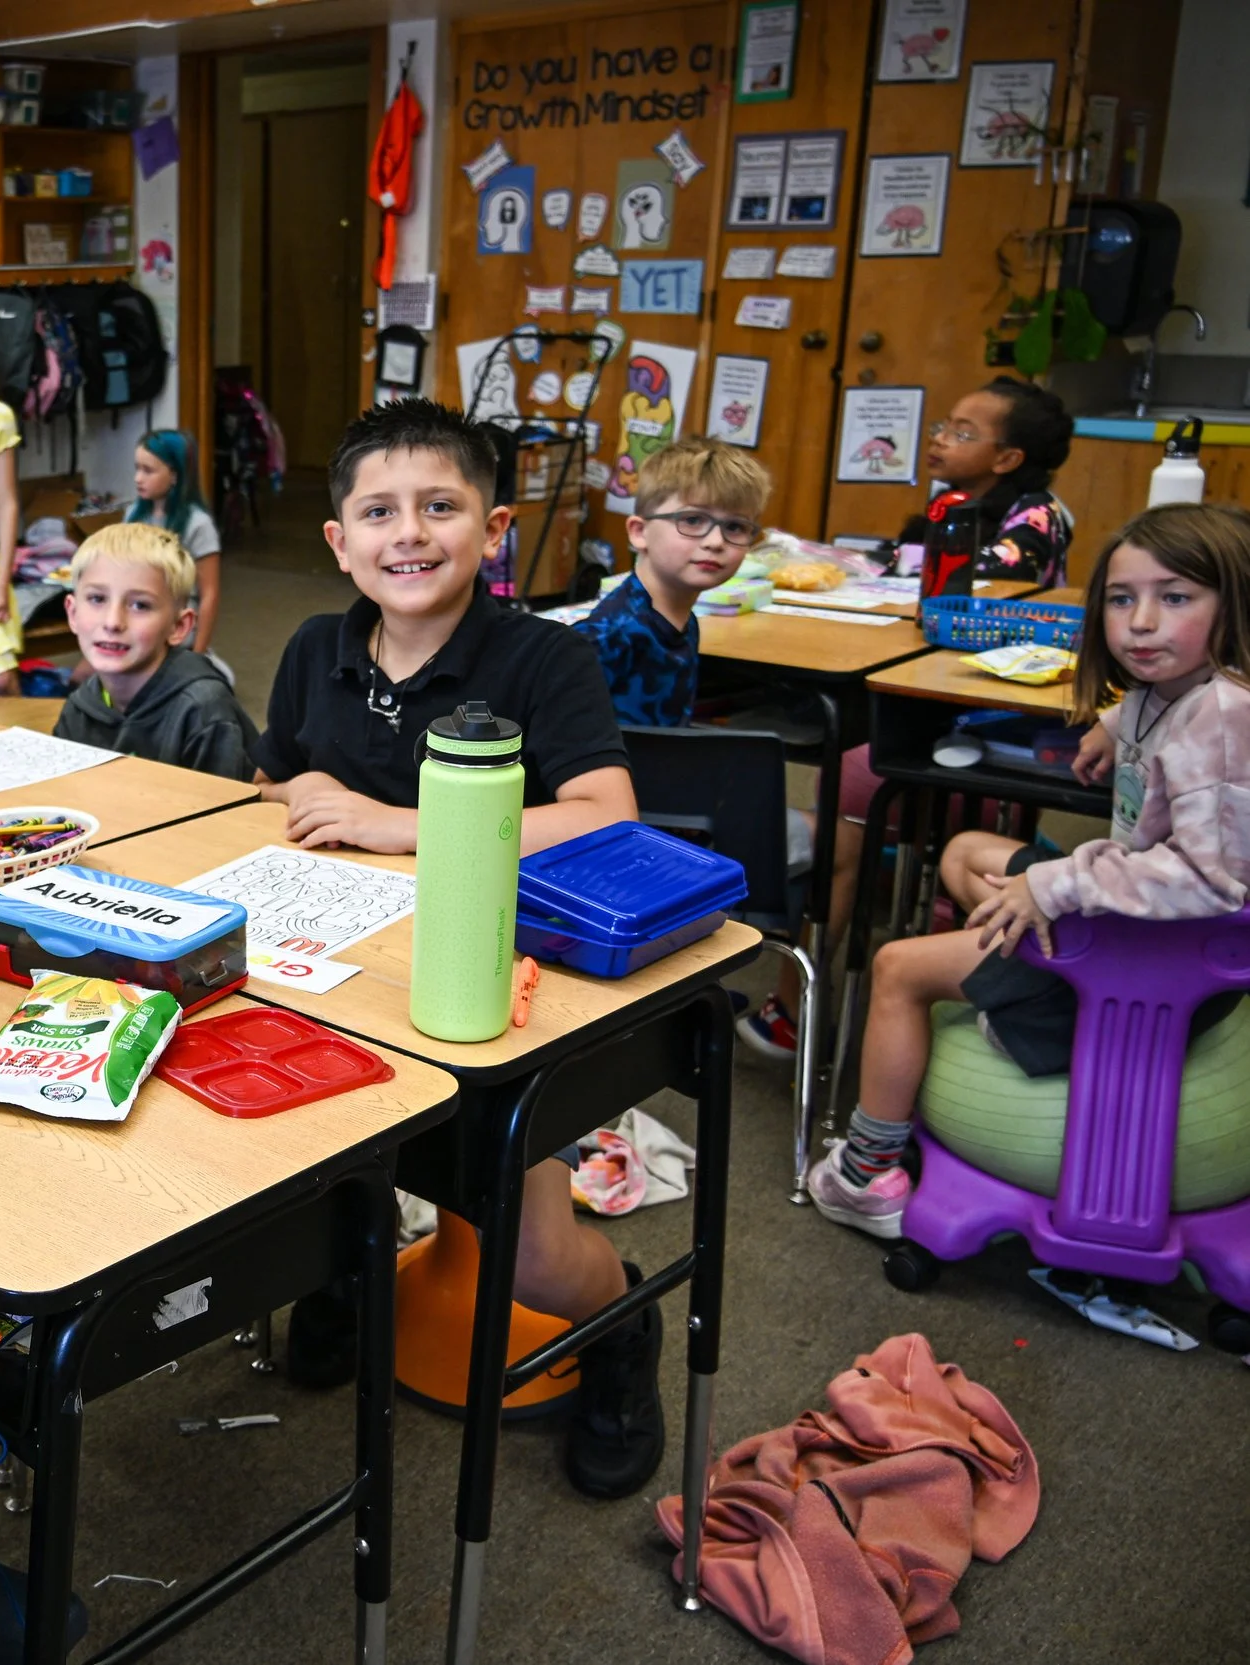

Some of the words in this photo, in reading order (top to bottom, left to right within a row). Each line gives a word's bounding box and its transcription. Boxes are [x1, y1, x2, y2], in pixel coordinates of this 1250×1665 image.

[474, 61, 509, 93] Do
[519, 56, 577, 95] you
[590, 46, 678, 81] have
[688, 43, 714, 73] a
[463, 98, 580, 131] Growth
[584, 84, 710, 126] Mindset
[629, 267, 689, 310] YET
[24, 882, 182, 925] Aubriella
[494, 907, 506, 978] ThermoFlask
[13, 1035, 91, 1051] Straws
[30, 1023, 57, 1035] Salt
[59, 1026, 86, 1036] Sea
